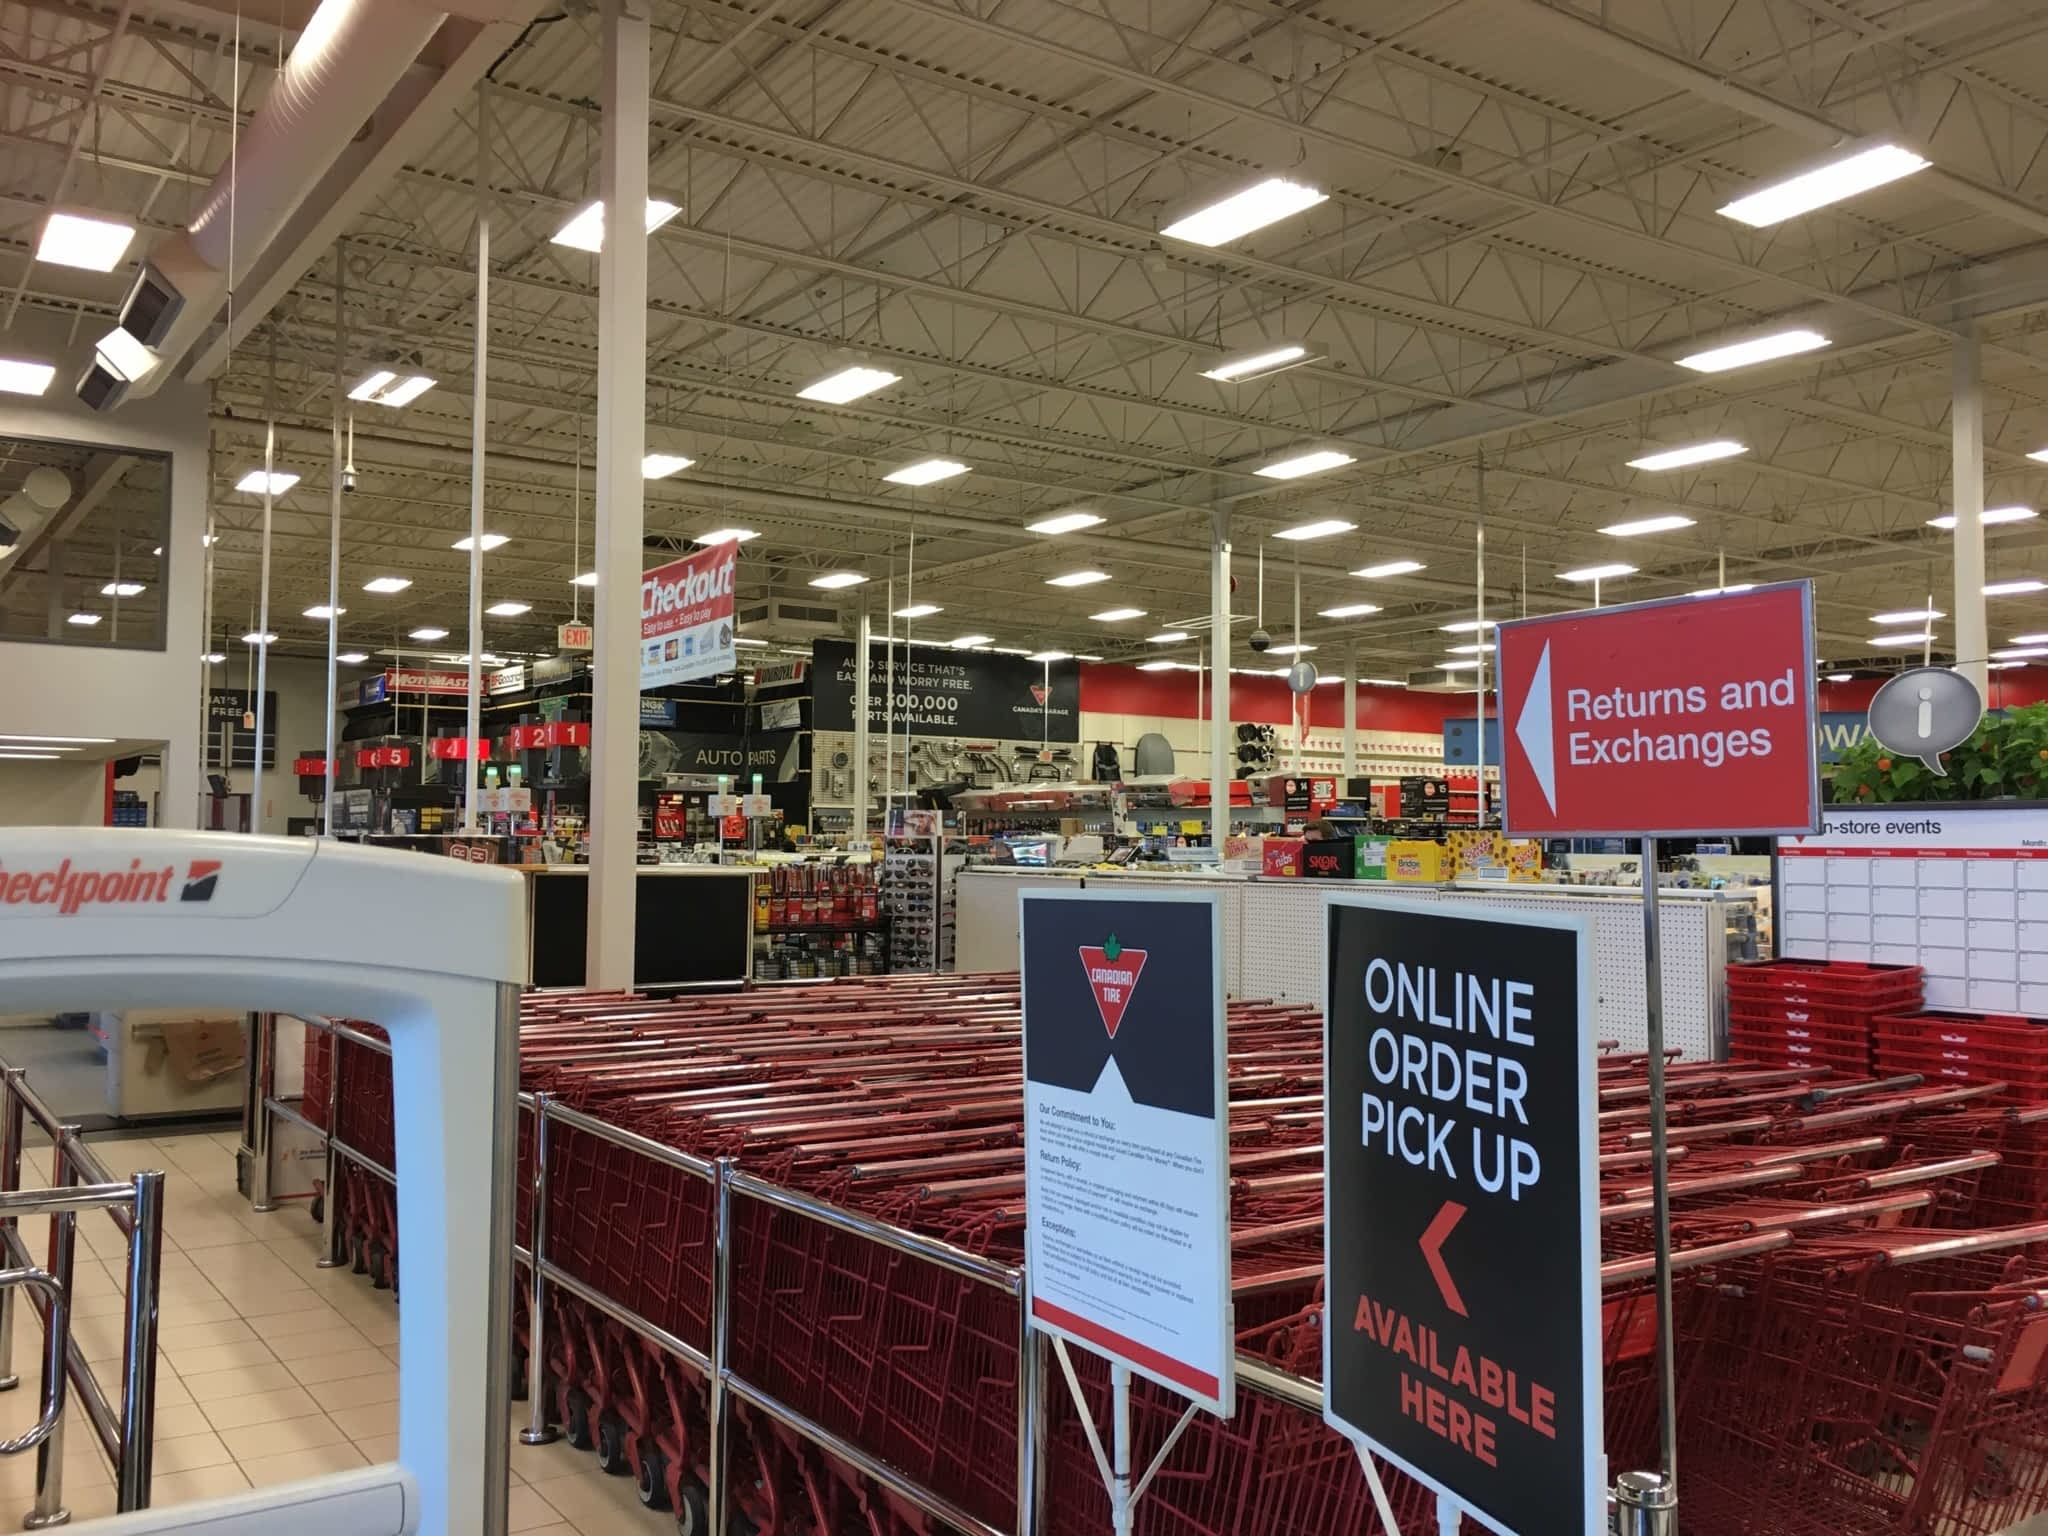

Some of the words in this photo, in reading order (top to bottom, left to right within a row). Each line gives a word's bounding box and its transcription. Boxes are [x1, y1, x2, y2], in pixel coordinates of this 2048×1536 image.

[640, 554, 735, 620] Checkout
[680, 612, 692, 625] Easy
[700, 607, 712, 623] pay
[566, 629, 589, 646] EXIT
[842, 657, 875, 669] AUO
[878, 660, 925, 673] SERVCE
[927, 663, 966, 676] THAT'S
[836, 671, 862, 682] EAS
[870, 673, 892, 684] AN
[897, 674, 940, 687] WORRY
[849, 694, 882, 707] OER
[1567, 685, 1707, 722] Returns
[1720, 668, 1795, 710] and
[851, 709, 889, 721] PRTS
[1044, 708, 1069, 716] ARAGE
[533, 728, 545, 747] 2
[567, 725, 576, 744] 1
[390, 749, 401, 765] 5
[1568, 728, 1772, 767] Exchanges
[696, 750, 743, 766] AUTO
[748, 749, 776, 766] PARTS
[1823, 819, 1881, 835] n-store
[1885, 819, 1941, 835] events
[1308, 854, 1341, 871] SKOR
[0, 858, 174, 914] eckpoint
[1091, 967, 1133, 986] CANADIAN
[1103, 987, 1121, 1003] TIRE
[1364, 957, 1535, 1047] ONLINE
[1368, 1027, 1529, 1126] ORDER
[1039, 1103, 1050, 1114] Our
[1051, 1106, 1092, 1125] Commitment
[1092, 1115, 1100, 1126] to
[1100, 1117, 1116, 1131] You:
[1361, 1091, 1457, 1180] PICK
[1472, 1126, 1541, 1202] UP
[1040, 1149, 1060, 1165] Return
[1354, 1293, 1557, 1440] AVAILABLE
[1401, 1371, 1497, 1468] HERE
